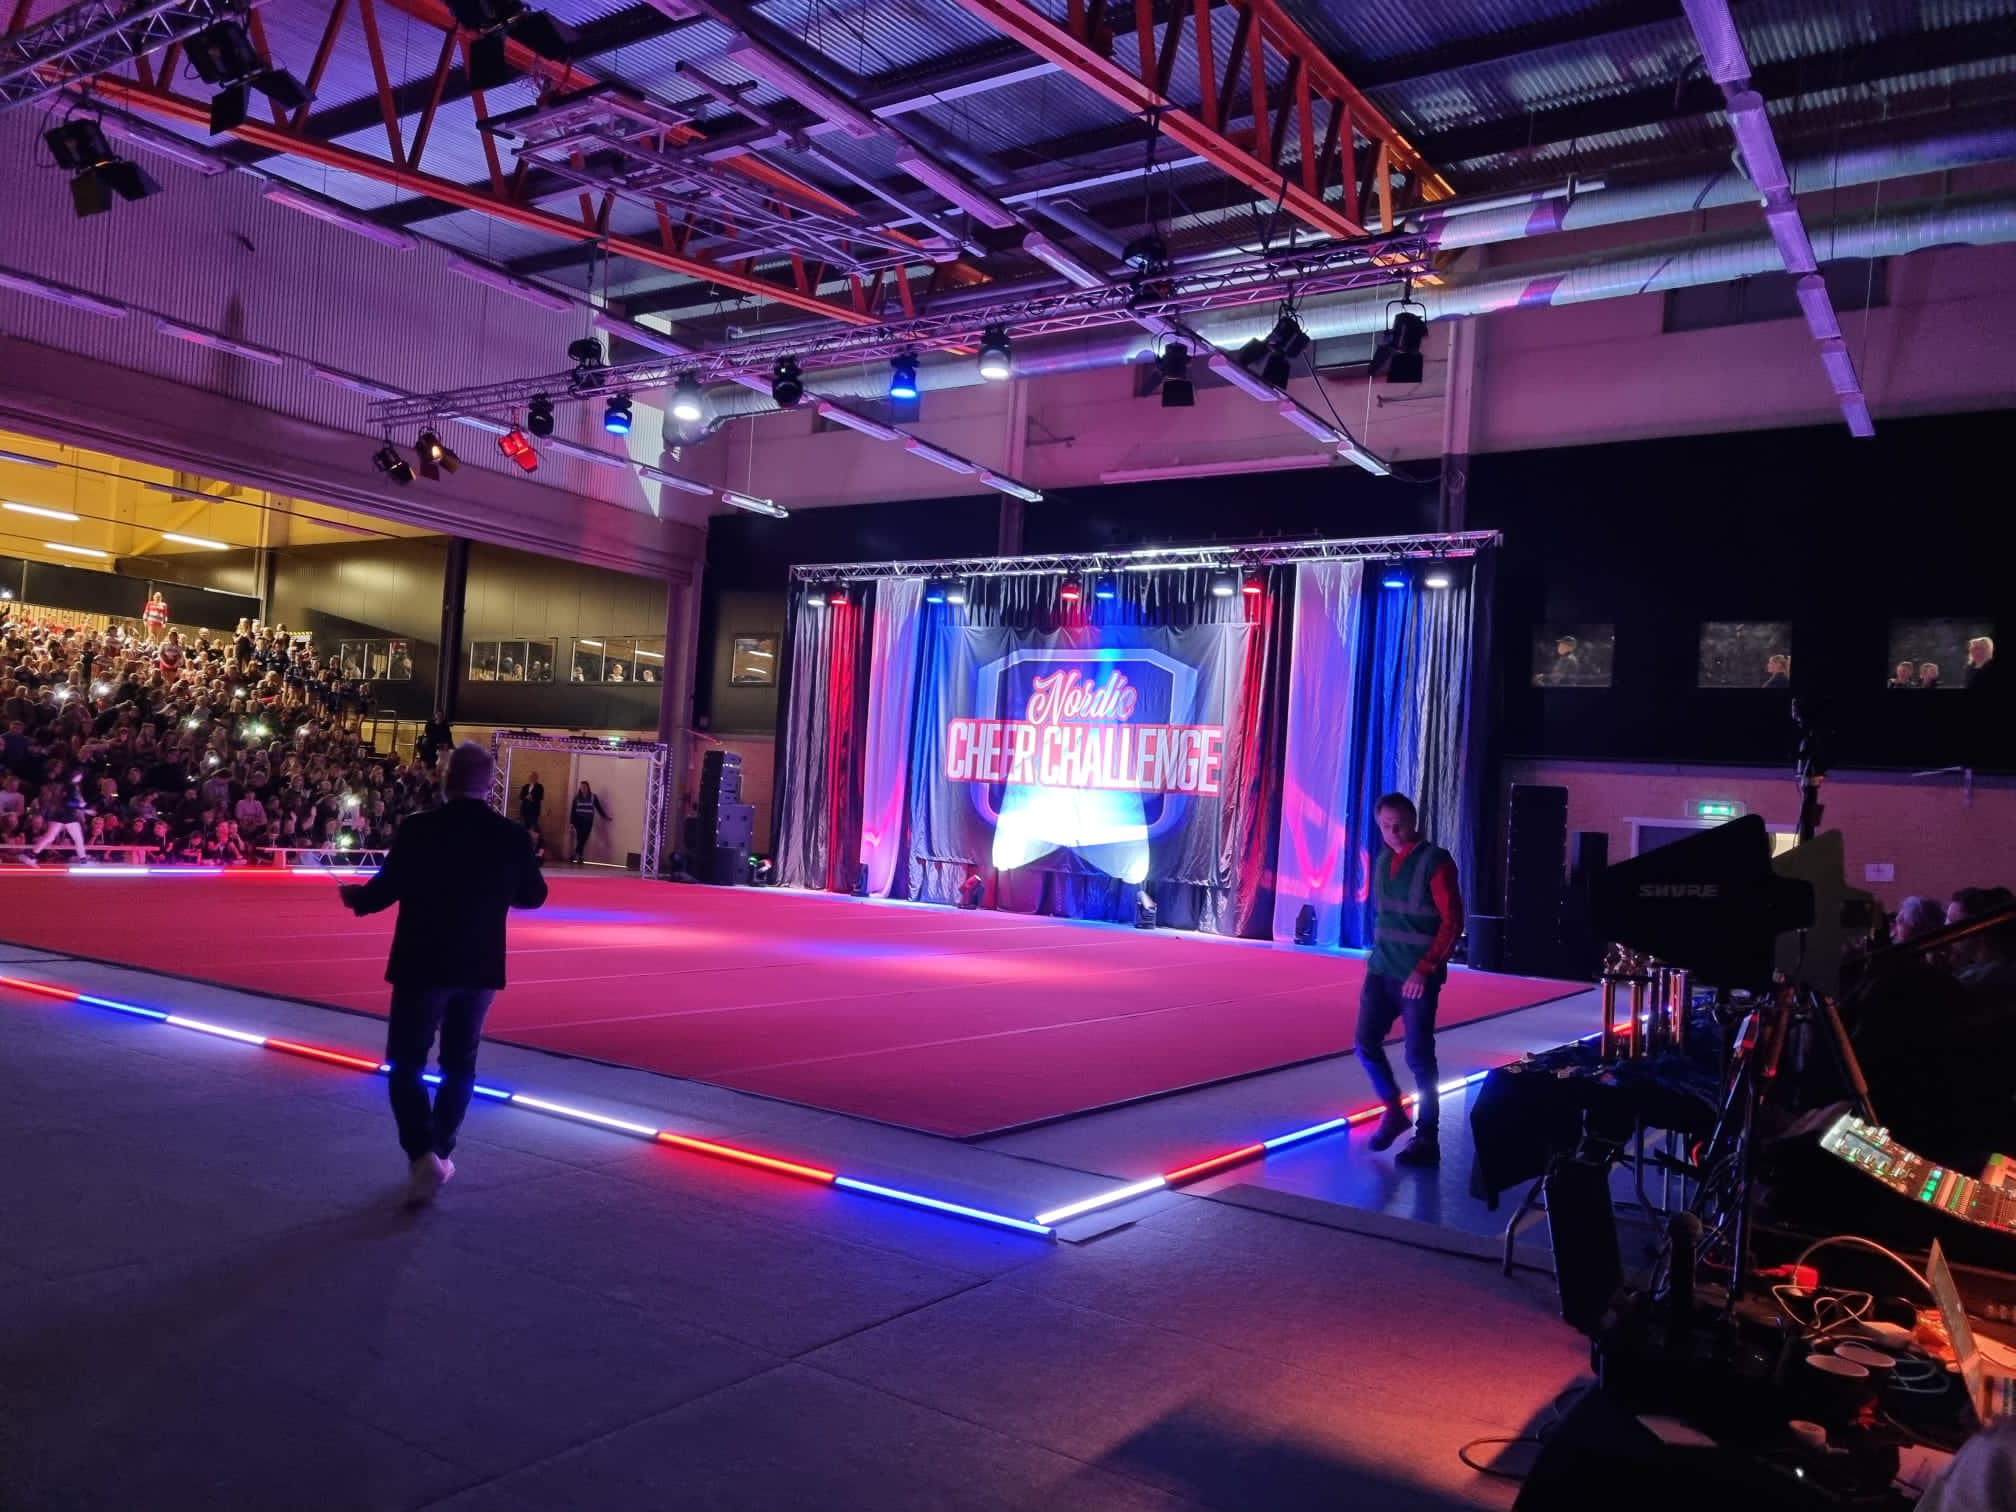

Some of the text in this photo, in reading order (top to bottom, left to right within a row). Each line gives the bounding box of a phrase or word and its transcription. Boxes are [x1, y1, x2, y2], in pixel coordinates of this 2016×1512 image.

[1028, 671, 1136, 725] Nordic
[947, 721, 1221, 793] CHEER CHALLENGE
[1639, 883, 1720, 898] SHURE
